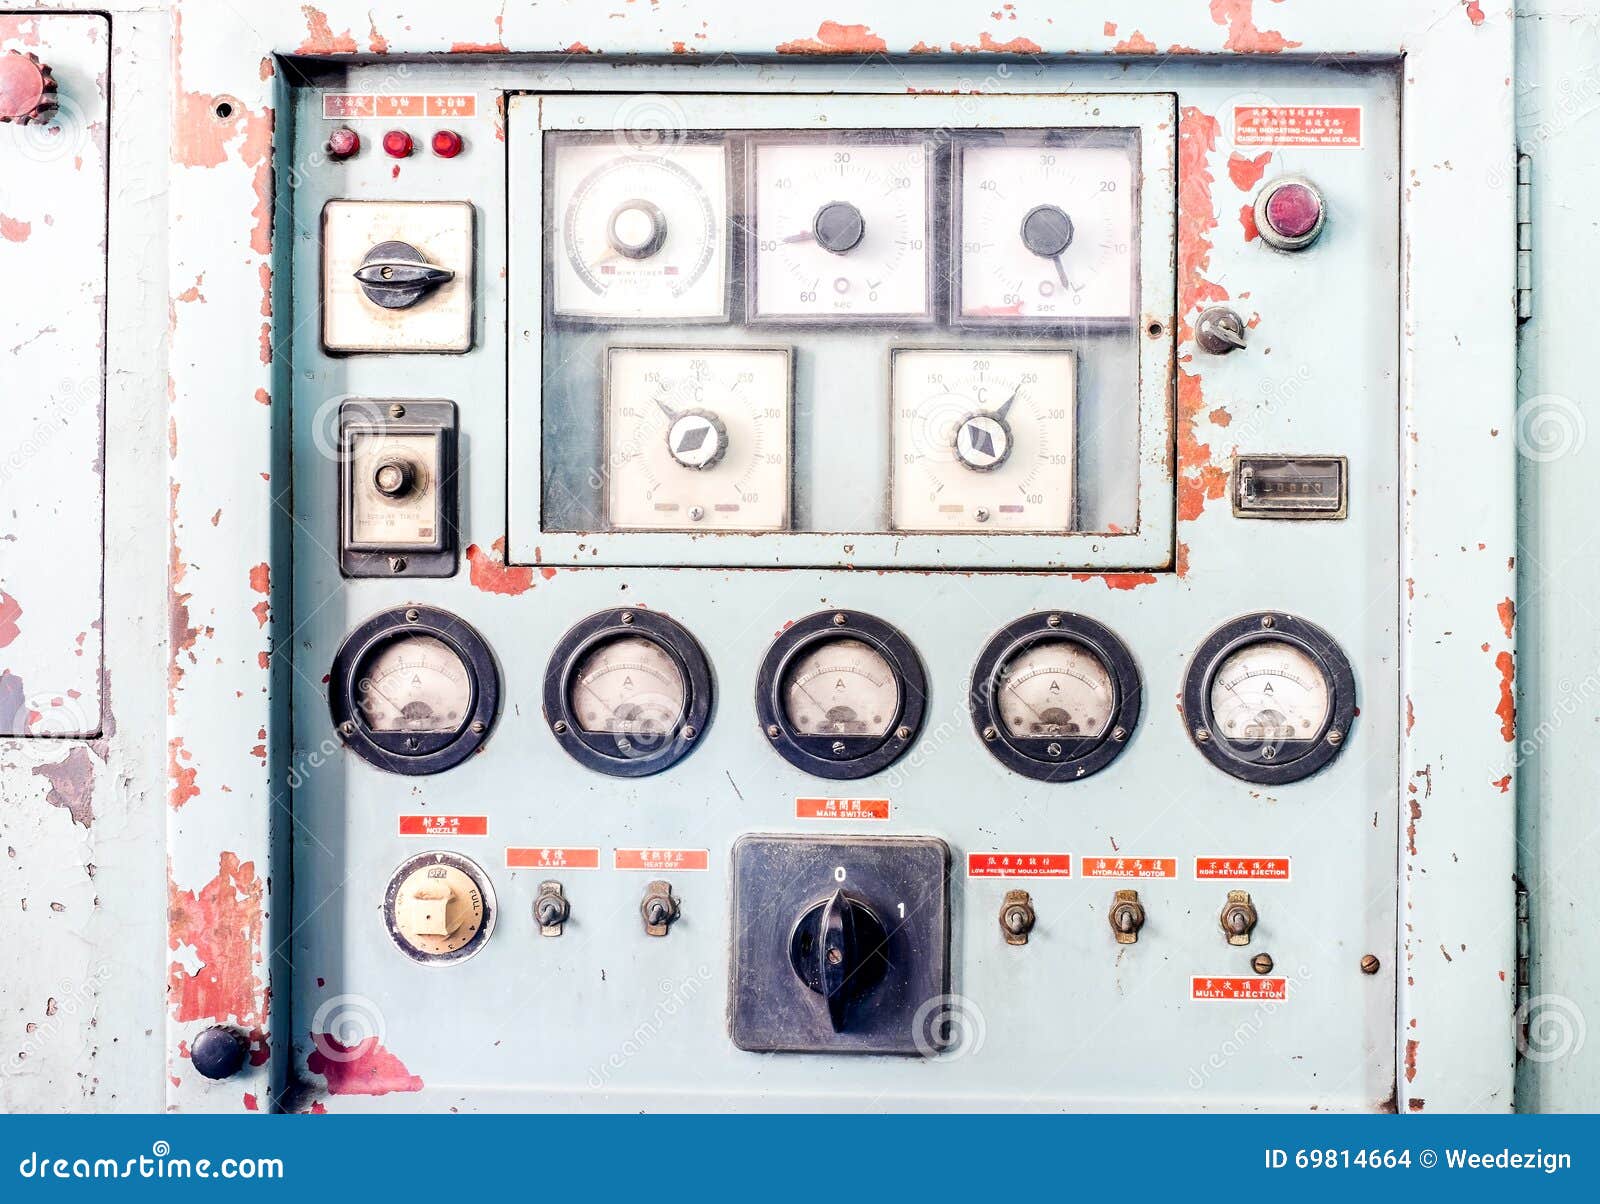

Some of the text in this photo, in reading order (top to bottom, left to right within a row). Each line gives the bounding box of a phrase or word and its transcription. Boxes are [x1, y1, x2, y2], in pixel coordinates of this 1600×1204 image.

[833, 152, 851, 164] 30
[1039, 155, 1056, 166] 30
[774, 178, 792, 188] 40
[979, 180, 997, 191] 40
[1099, 181, 1116, 192] 20
[760, 240, 777, 252] 50
[910, 240, 922, 250] 10
[1114, 244, 1127, 254] 10
[800, 291, 817, 303] 60
[869, 291, 878, 302] 0
[1072, 294, 1081, 305] 0
[1037, 304, 1055, 312] sec
[972, 360, 990, 371] 200
[644, 373, 660, 383] 150
[1020, 373, 1038, 384] 250
[763, 408, 781, 418] 300
[1048, 409, 1065, 419] 300
[766, 454, 782, 464] 350
[904, 454, 915, 464] 50
[1050, 455, 1066, 465] 350
[741, 493, 759, 503] 400
[1025, 494, 1043, 504] 400
[834, 866, 846, 882] 0
[1091, 869, 1134, 877] HYDRAULIC
[469, 889, 481, 911] FULL
[897, 902, 905, 918] 1
[1233, 990, 1283, 998] EJECTION
